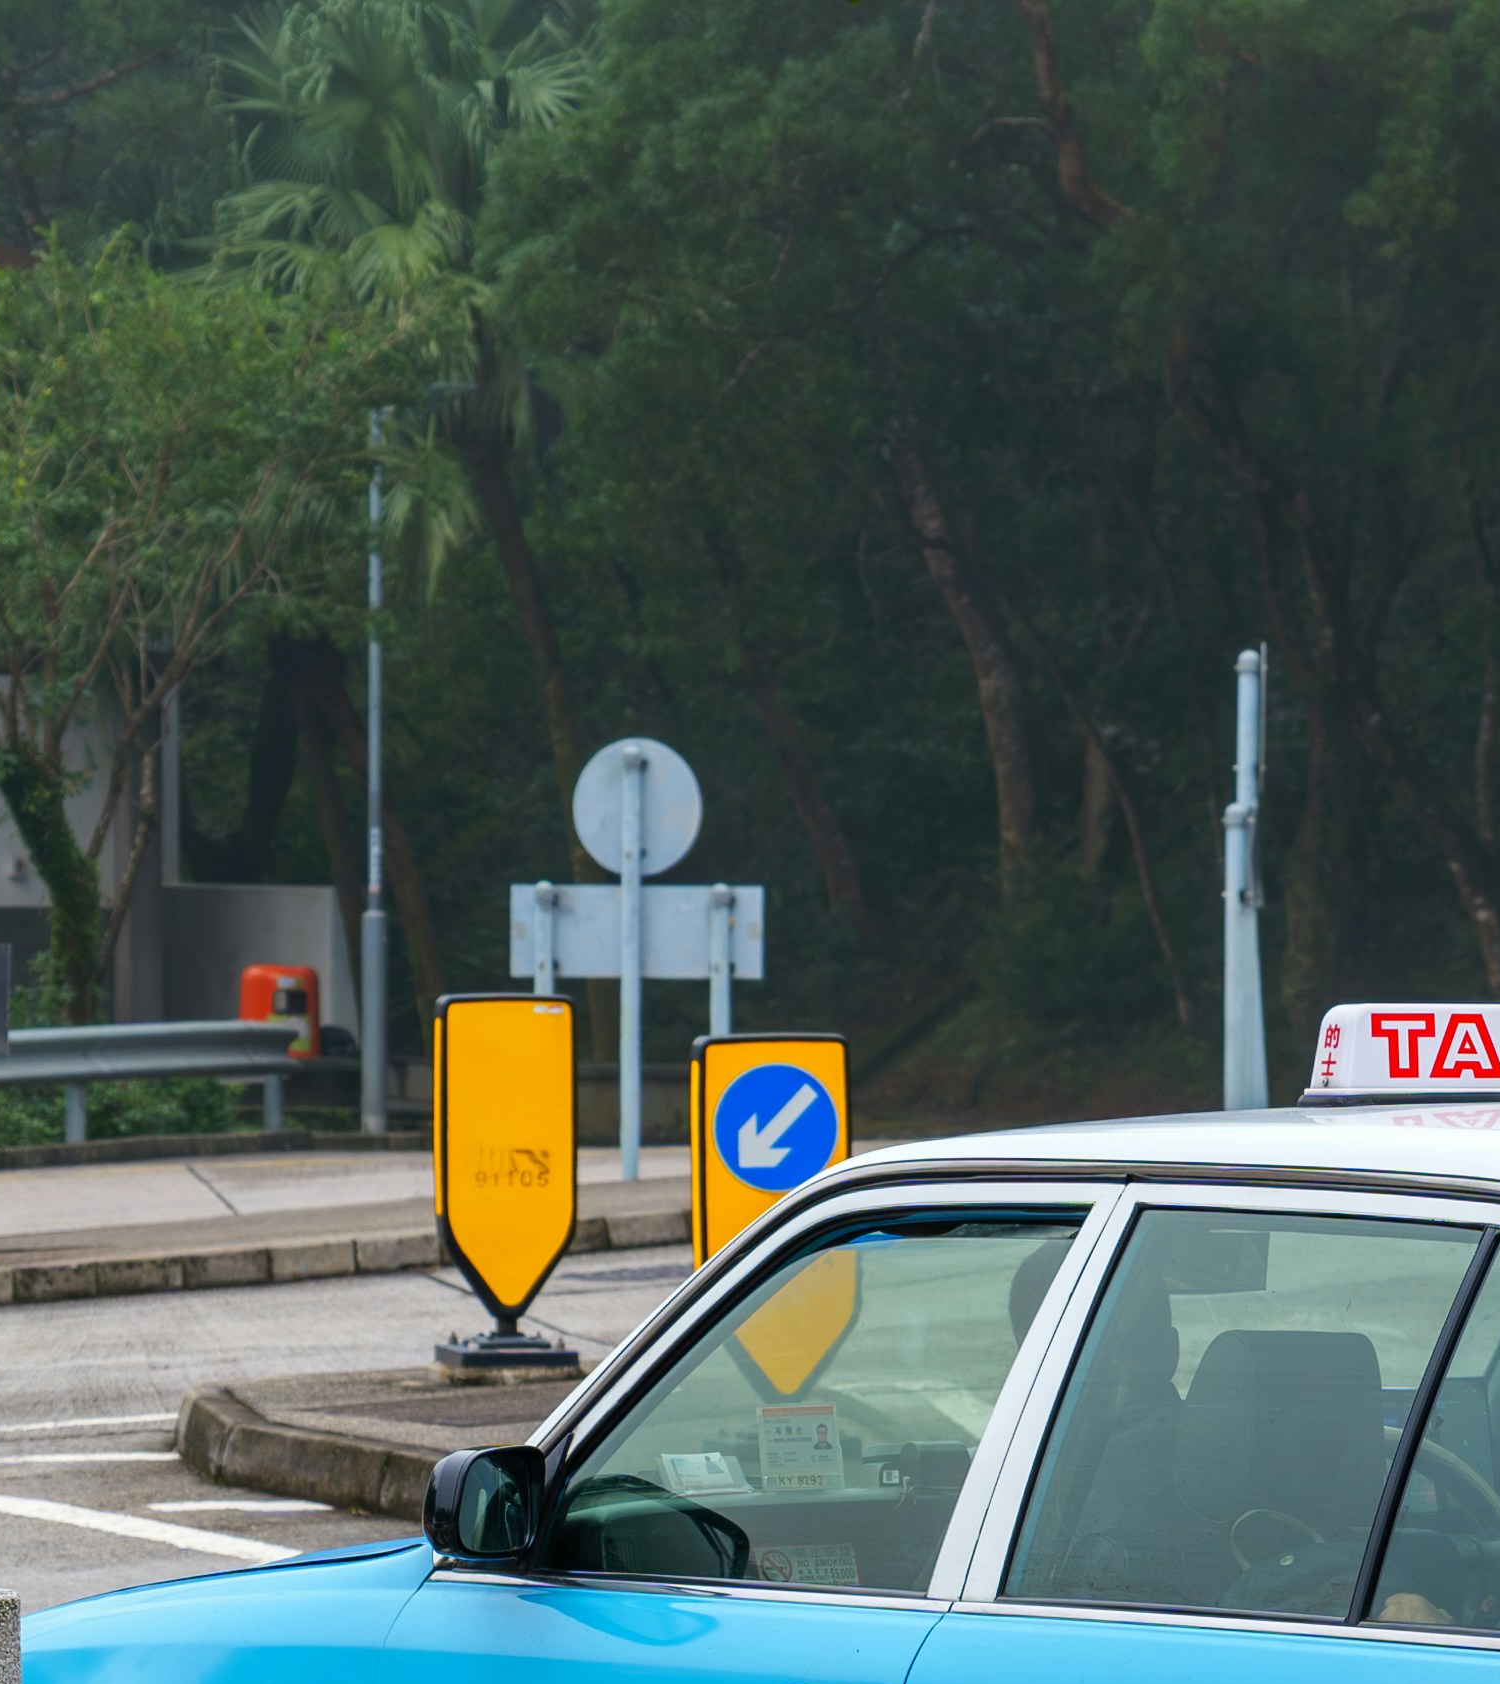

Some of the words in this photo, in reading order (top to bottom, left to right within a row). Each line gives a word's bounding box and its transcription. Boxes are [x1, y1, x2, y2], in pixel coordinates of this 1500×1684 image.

[1320, 1024, 1341, 1076] 的士
[474, 1170, 550, 1188] 91105
[779, 1474, 793, 1486] KY
